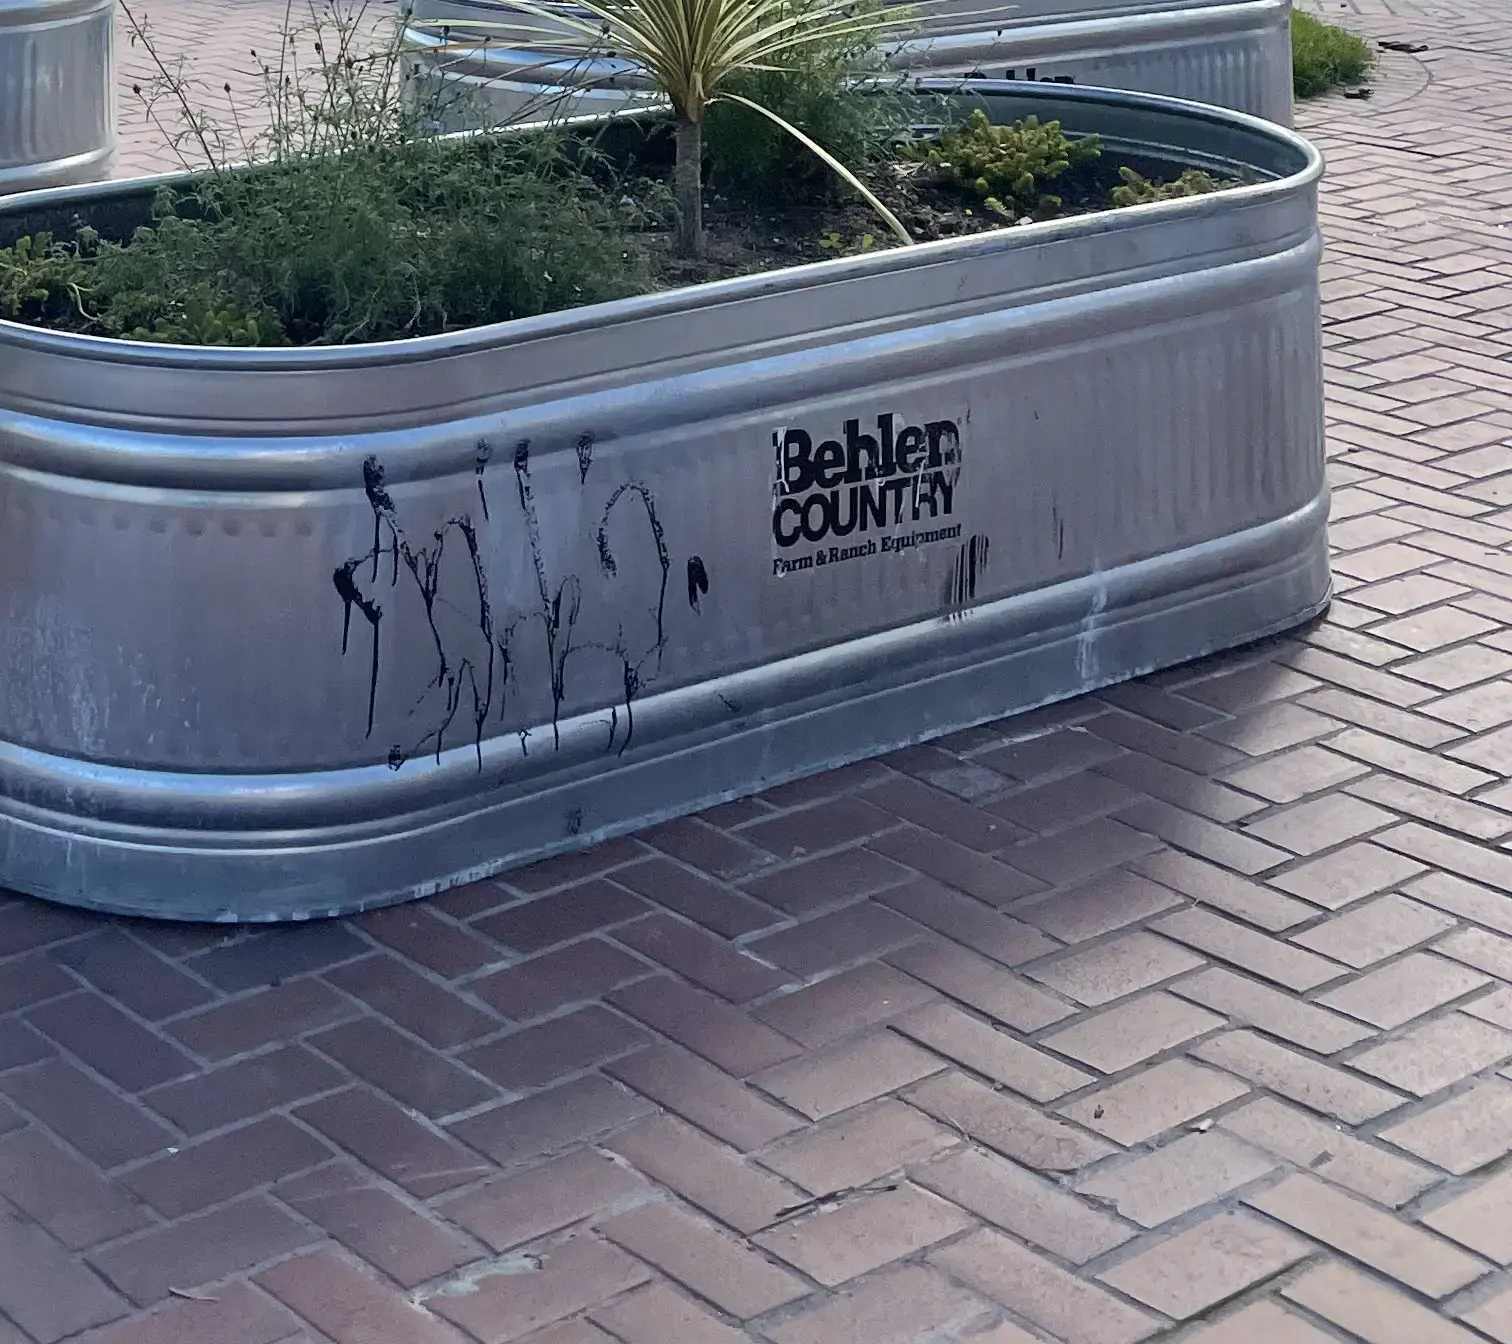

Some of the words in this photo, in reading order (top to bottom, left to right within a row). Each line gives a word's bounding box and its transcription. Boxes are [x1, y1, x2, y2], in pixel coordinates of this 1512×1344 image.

[772, 413, 962, 497] Behlen
[772, 472, 962, 548] COUNTRY
[773, 554, 813, 575] Farm
[829, 539, 877, 563] Ranch
[881, 523, 962, 553] Equipment
